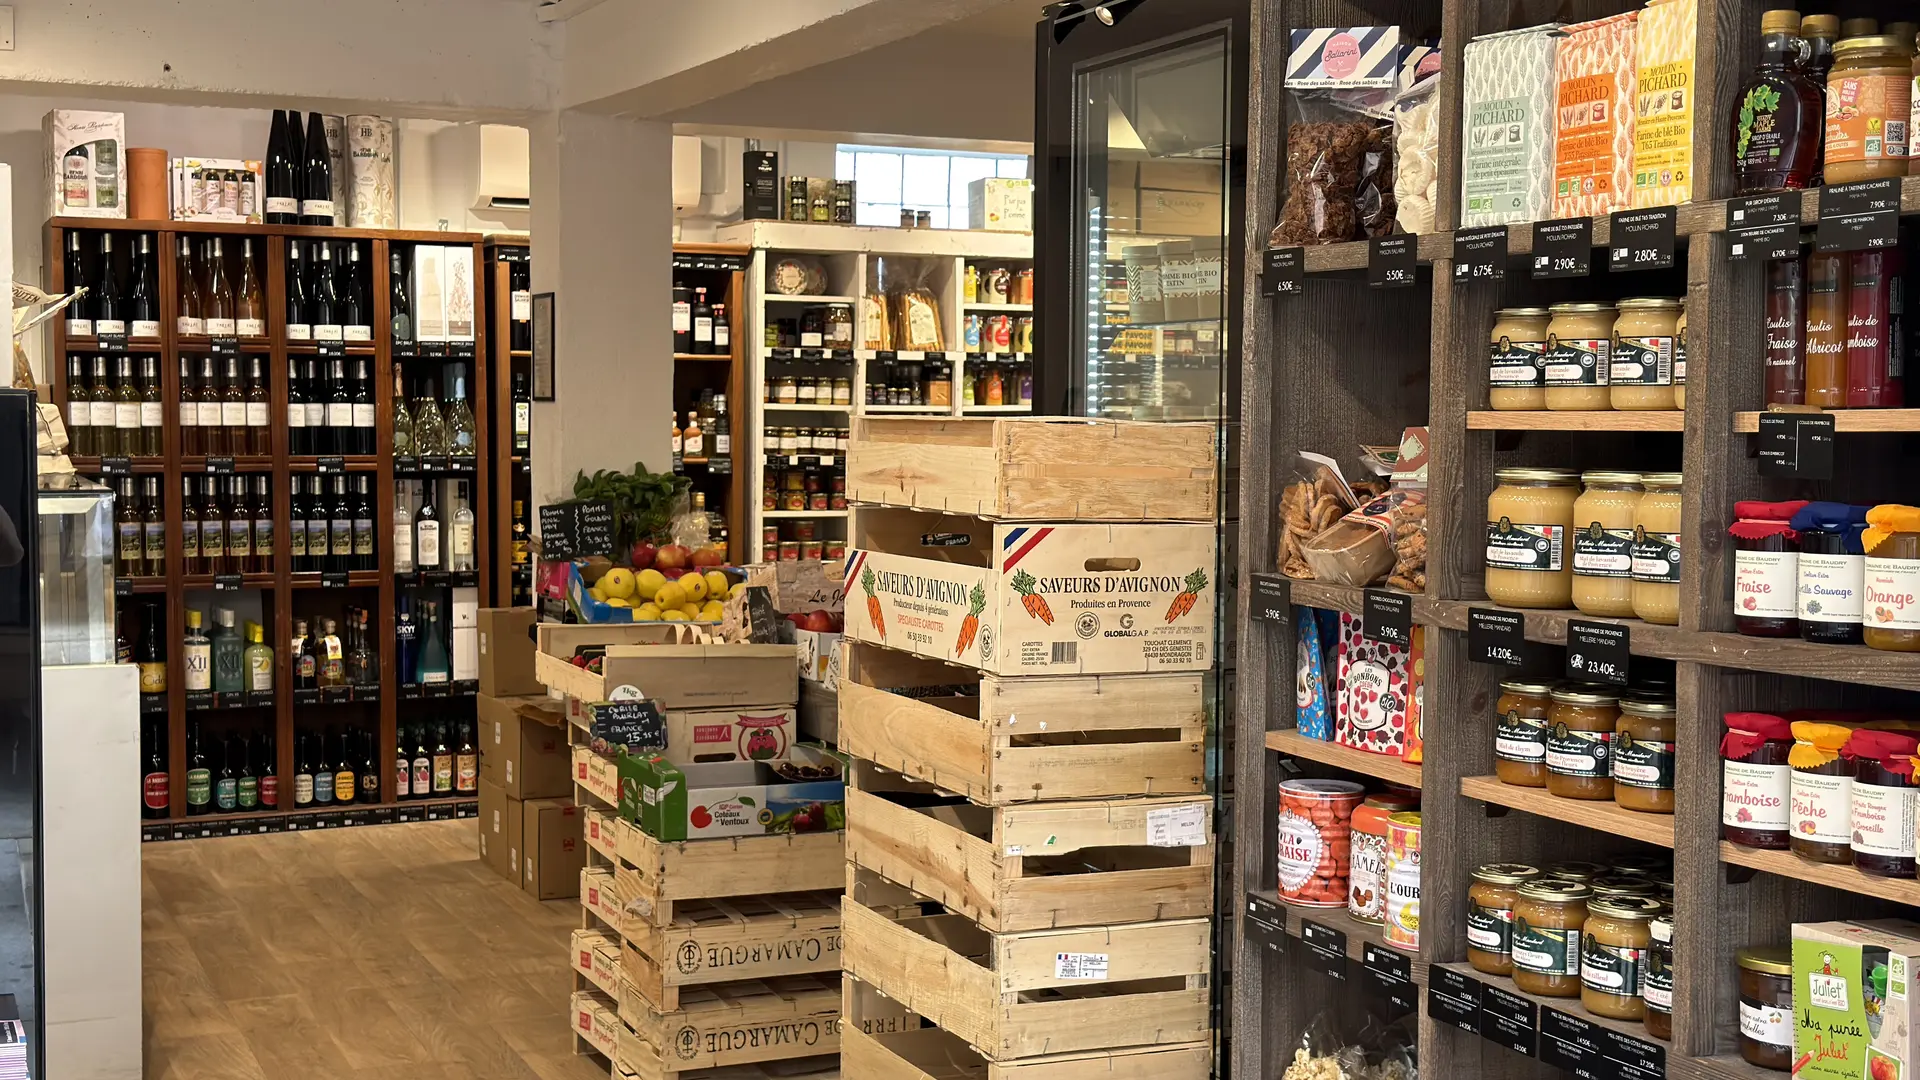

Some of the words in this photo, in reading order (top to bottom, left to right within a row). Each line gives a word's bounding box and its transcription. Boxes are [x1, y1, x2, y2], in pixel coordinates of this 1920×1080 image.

[1650, 64, 1677, 77] MOULIN
[1568, 78, 1596, 90] MOULIN
[1638, 72, 1688, 94] PICHARD
[1843, 80, 1858, 90] SANS
[1560, 86, 1609, 106] PICHARD
[1484, 100, 1512, 111] MOULIN
[1473, 108, 1524, 126] PICHARD
[1753, 119, 1776, 128] MAPLE
[360, 127, 372, 138] HB
[1636, 130, 1654, 141] Farine
[1655, 129, 1662, 138] de
[1662, 127, 1672, 136] blé
[1674, 126, 1686, 135] Bio
[1596, 136, 1608, 146] Bio
[1654, 138, 1678, 149] Tradition
[1472, 160, 1492, 170] Farine
[1493, 156, 1521, 169] intégrale
[1474, 170, 1480, 178] de
[1481, 170, 1493, 179] petit
[1634, 248, 1658, 262] 2.80€
[1474, 264, 1492, 276] 6.75€
[1554, 258, 1576, 270] 2.90€
[1182, 272, 1197, 280] BIO
[1204, 270, 1218, 278] BIO
[1386, 269, 1404, 282] 5.50€
[1277, 280, 1293, 292] 6.50€
[1866, 316, 1879, 326] de
[1768, 334, 1798, 350] Fraise
[1806, 338, 1844, 354] Abricot
[1772, 356, 1796, 366] naturel
[582, 504, 606, 514] POMME
[583, 526, 608, 534] FRANCE
[876, 570, 914, 598] SAVEURS
[916, 576, 968, 606] D'AVIGNON
[1040, 576, 1101, 594] SAVEURS
[1104, 576, 1182, 593] D'AVIGNON
[1736, 576, 1772, 594] Fraise
[808, 588, 826, 602] Le
[1814, 585, 1853, 600] Sauvage
[1866, 586, 1915, 610] Orange
[893, 598, 912, 611] Producteur
[913, 602, 924, 613] depuis
[928, 606, 948, 617] générations
[1070, 599, 1106, 608] Produites
[1118, 599, 1152, 608] Provence
[1265, 608, 1280, 620] 5.90€
[397, 625, 415, 634] SKYY
[898, 614, 922, 628] SPECIALISTE
[922, 619, 944, 632] CAROTTES
[1381, 626, 1398, 638] 5.90€
[1487, 646, 1512, 660] 14.20€
[188, 657, 207, 670] XII
[1588, 660, 1616, 675] 23.40€
[142, 673, 164, 686] Cidr
[1354, 673, 1382, 687] BONBONS
[622, 687, 638, 698] 1kg
[611, 725, 644, 733] FRANCE
[362, 775, 378, 789] 83
[1792, 798, 1828, 819] Pêche
[720, 818, 750, 826] Ventoux
[1856, 822, 1884, 834] Groseille
[1283, 832, 1294, 845] LA
[707, 938, 822, 968] CAMARGUE
[1812, 978, 1842, 999] Juliet
[1801, 1008, 1822, 1031] Ma
[1828, 1020, 1862, 1038] purée
[705, 1022, 820, 1052] CAMARGUE
[1814, 1036, 1848, 1062] Juliet
